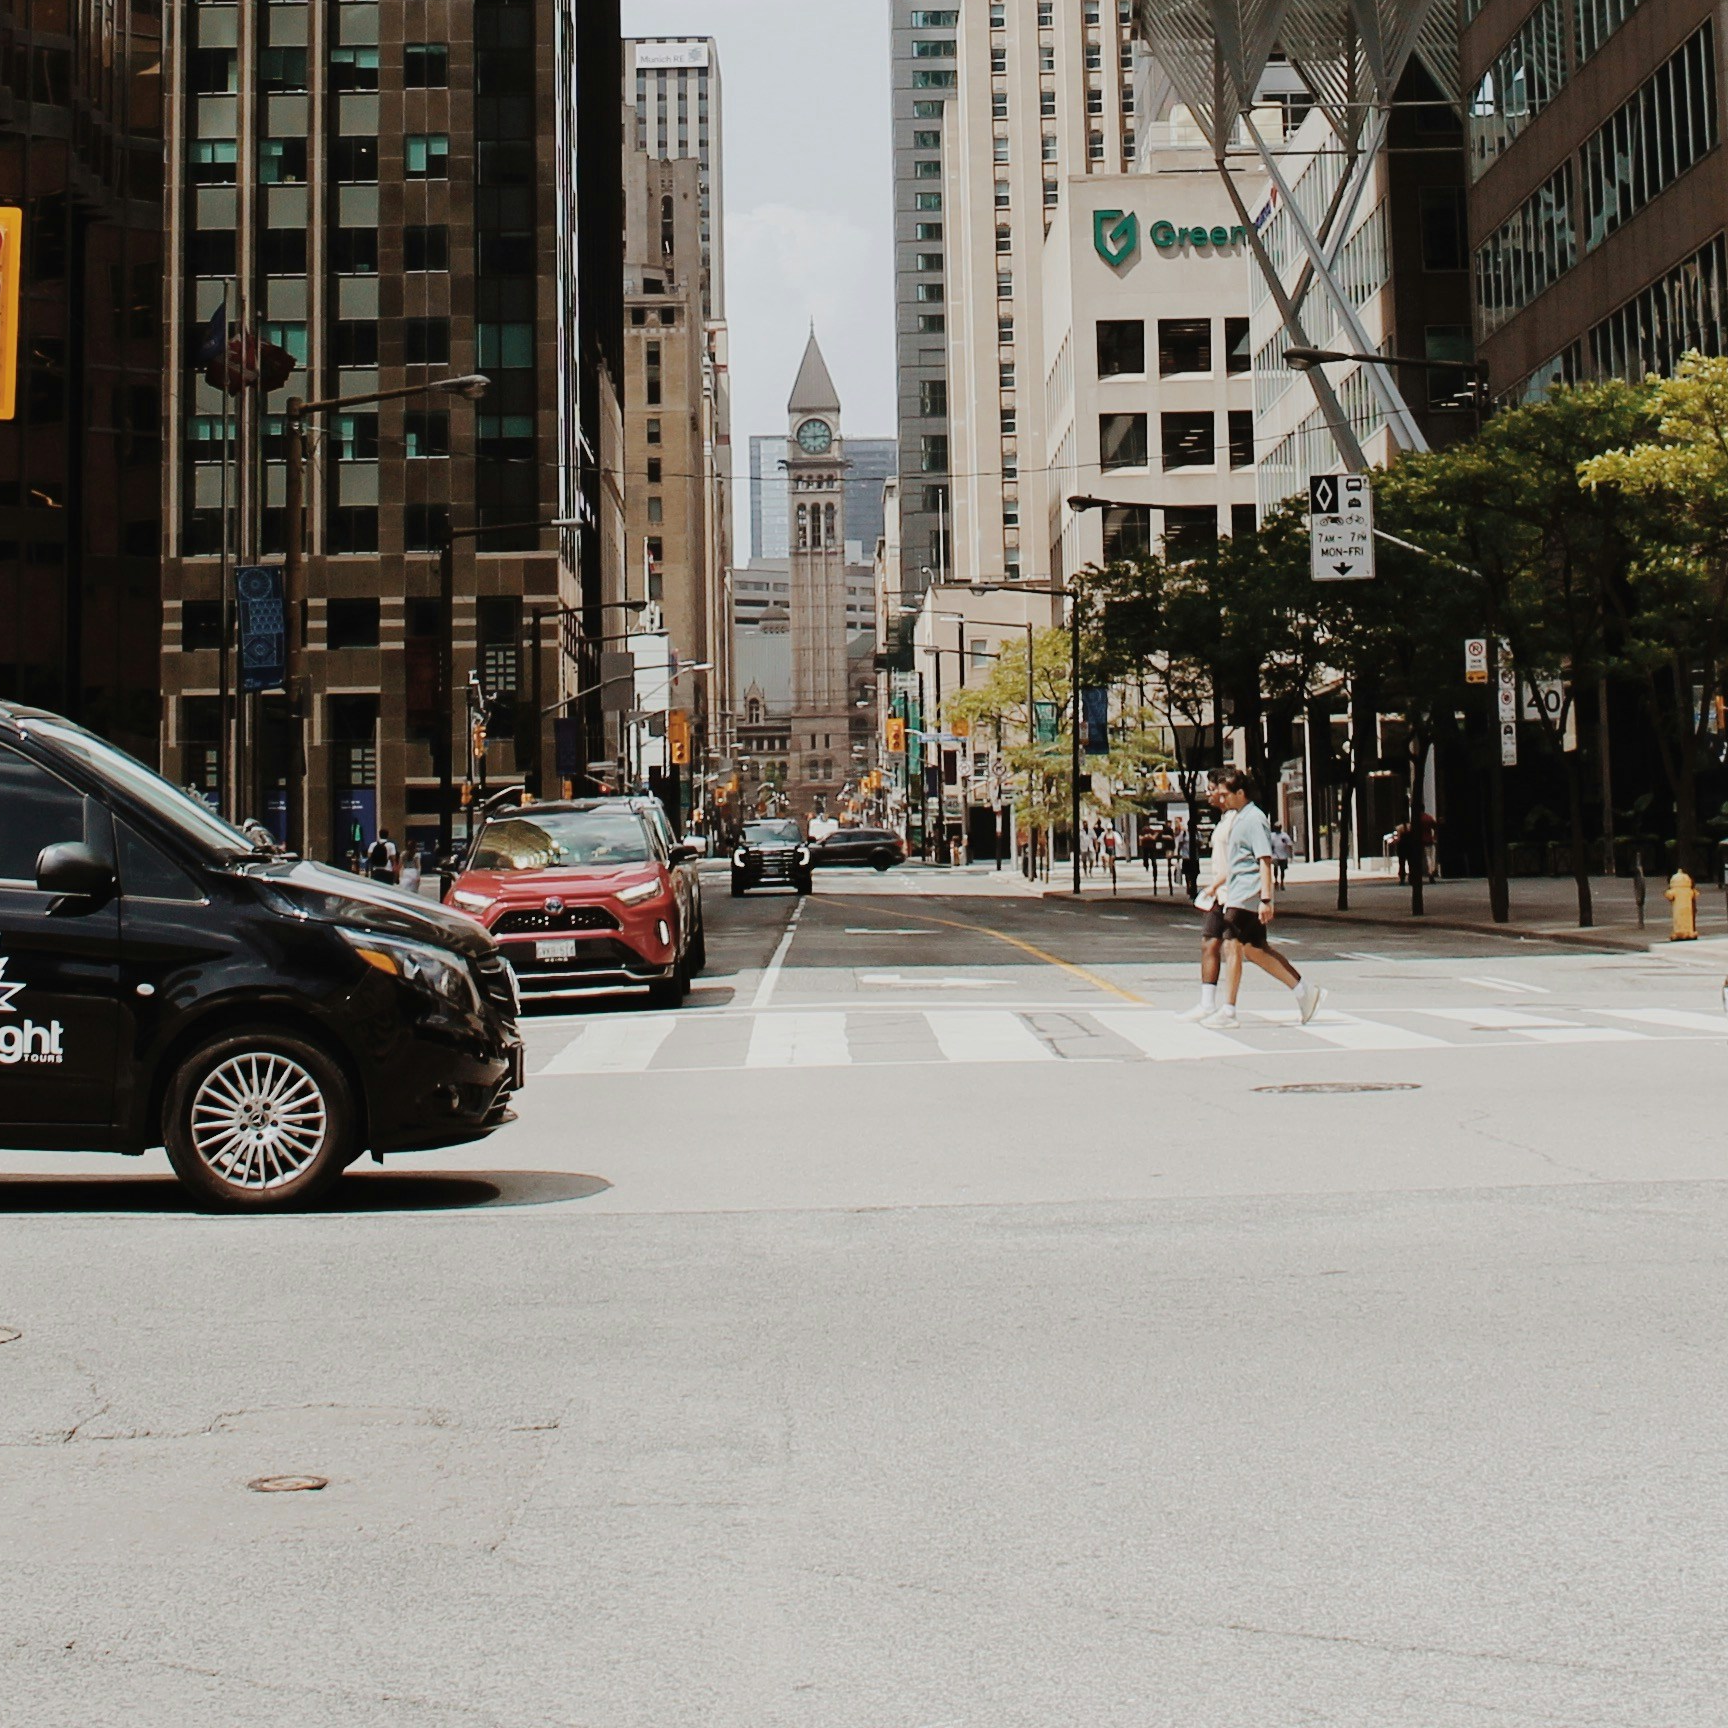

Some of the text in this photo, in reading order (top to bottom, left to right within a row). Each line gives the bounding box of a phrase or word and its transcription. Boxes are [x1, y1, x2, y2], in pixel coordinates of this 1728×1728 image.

[640, 54, 685, 64] Munich RE
[1321, 547, 1364, 557] MON-FRI
[24, 1053, 63, 1064] TOURS
